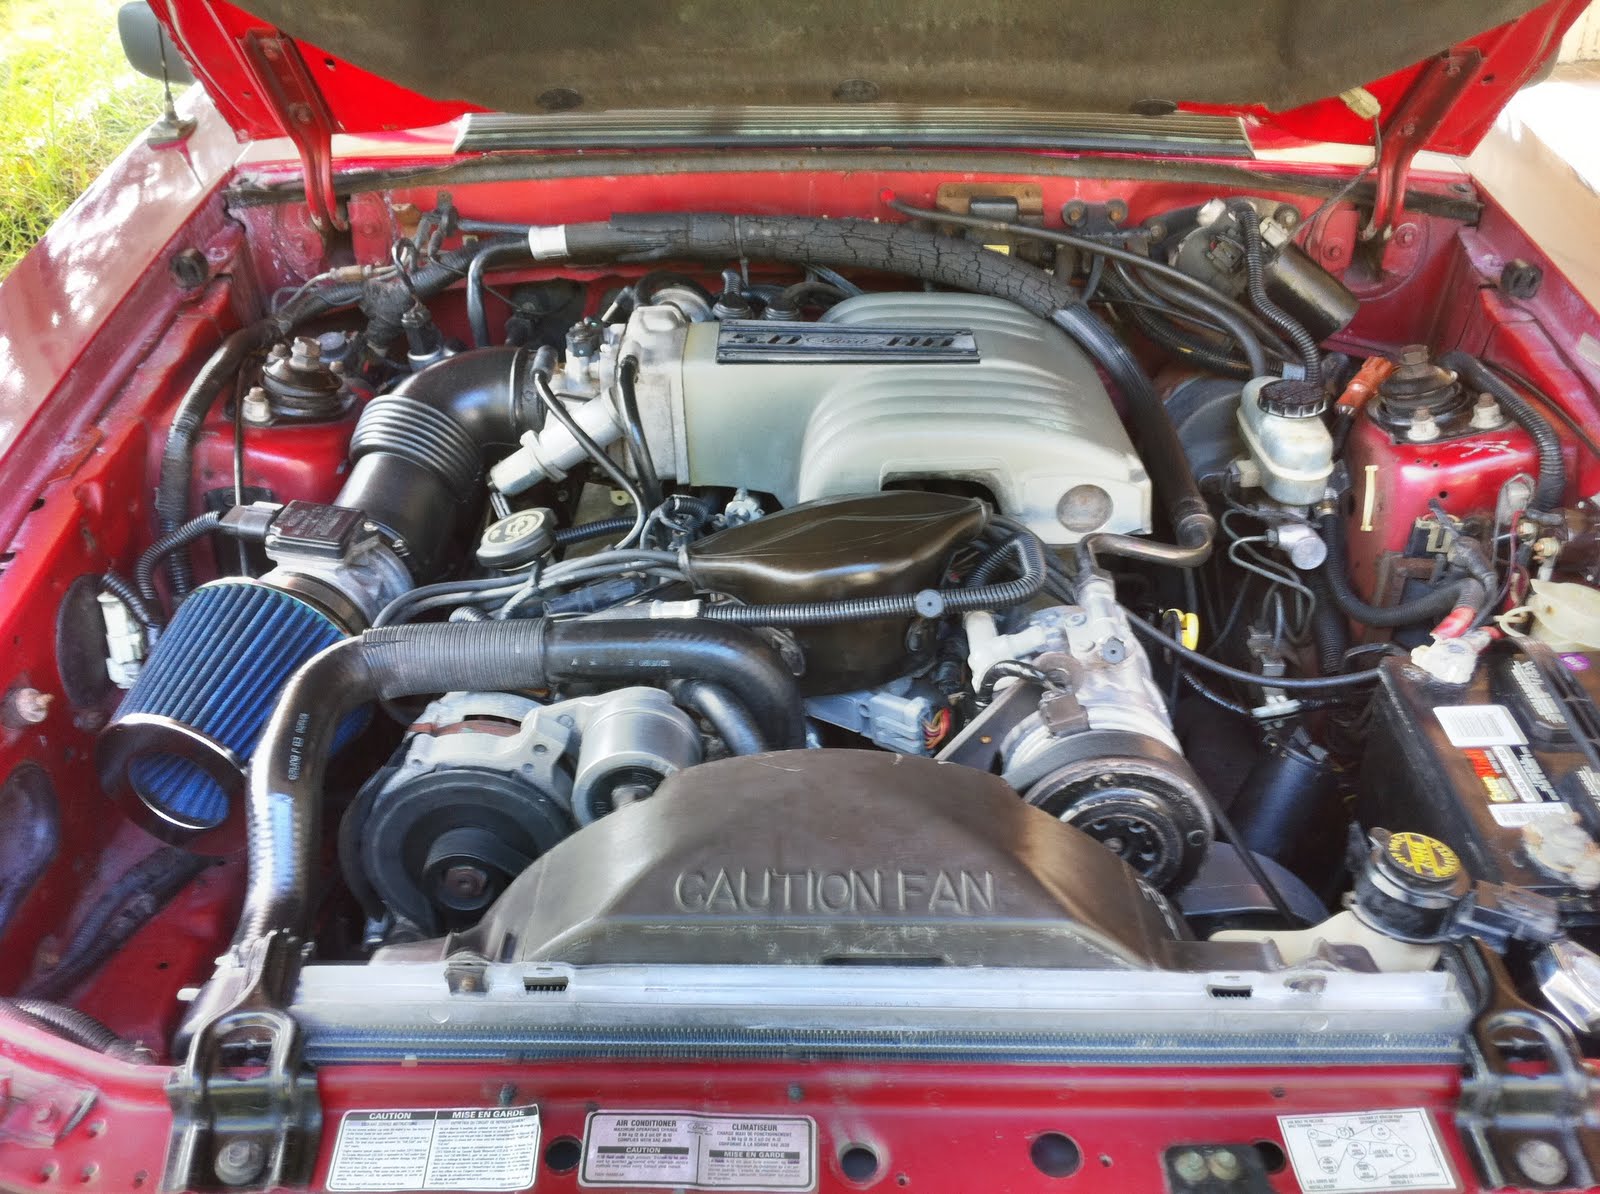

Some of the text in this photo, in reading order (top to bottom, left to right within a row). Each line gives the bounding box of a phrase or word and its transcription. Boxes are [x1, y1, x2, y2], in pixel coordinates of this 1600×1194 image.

[673, 867, 994, 914] CAUTION FAN
[369, 1112, 411, 1120] CAUTION
[452, 1109, 525, 1119] MISE EN GARDE
[631, 1119, 677, 1127] CONDITIONER
[732, 1123, 778, 1132] CLIMATISEUR
